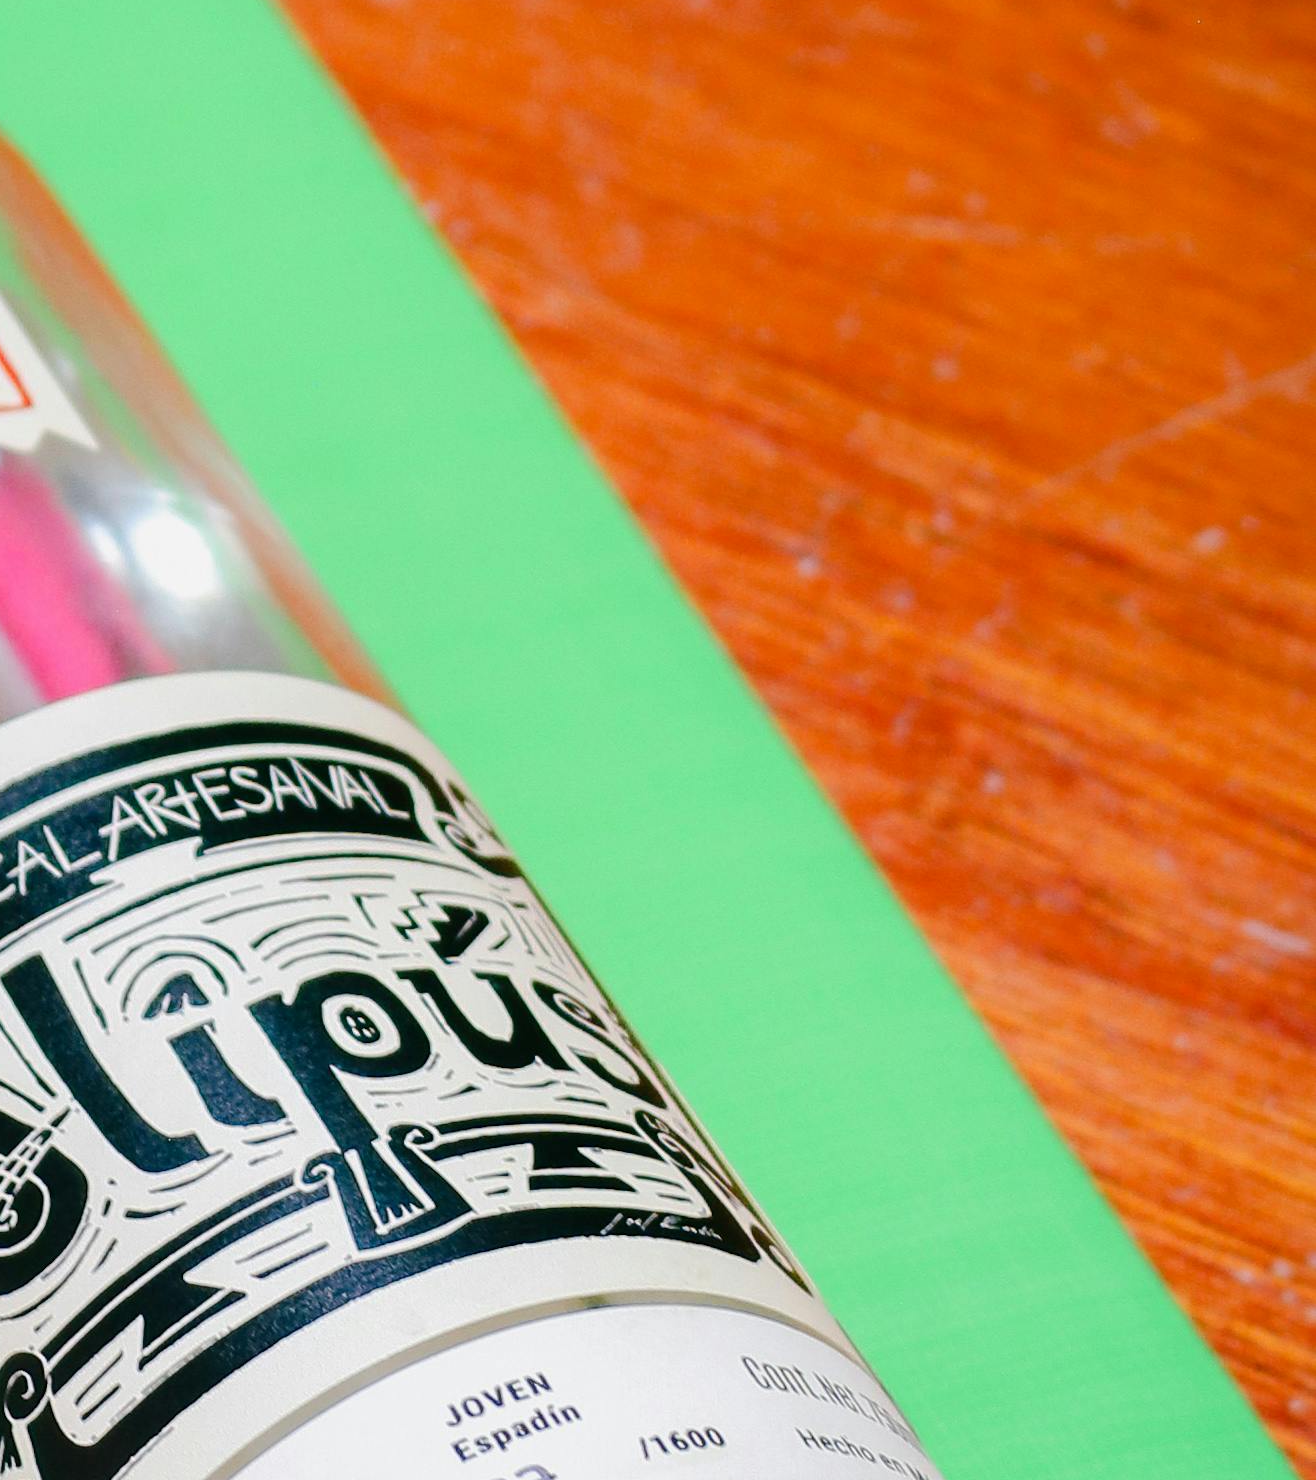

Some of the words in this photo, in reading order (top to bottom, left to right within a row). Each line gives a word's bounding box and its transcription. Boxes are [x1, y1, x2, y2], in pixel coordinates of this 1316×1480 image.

[98, 757, 411, 862] ARTESANAL
[445, 1370, 554, 1428] JOVEN
[741, 1354, 828, 1403] Cont.
[450, 1402, 584, 1463] Espadín
[637, 1425, 728, 1462] /1600
[795, 1426, 878, 1464] Hecho
